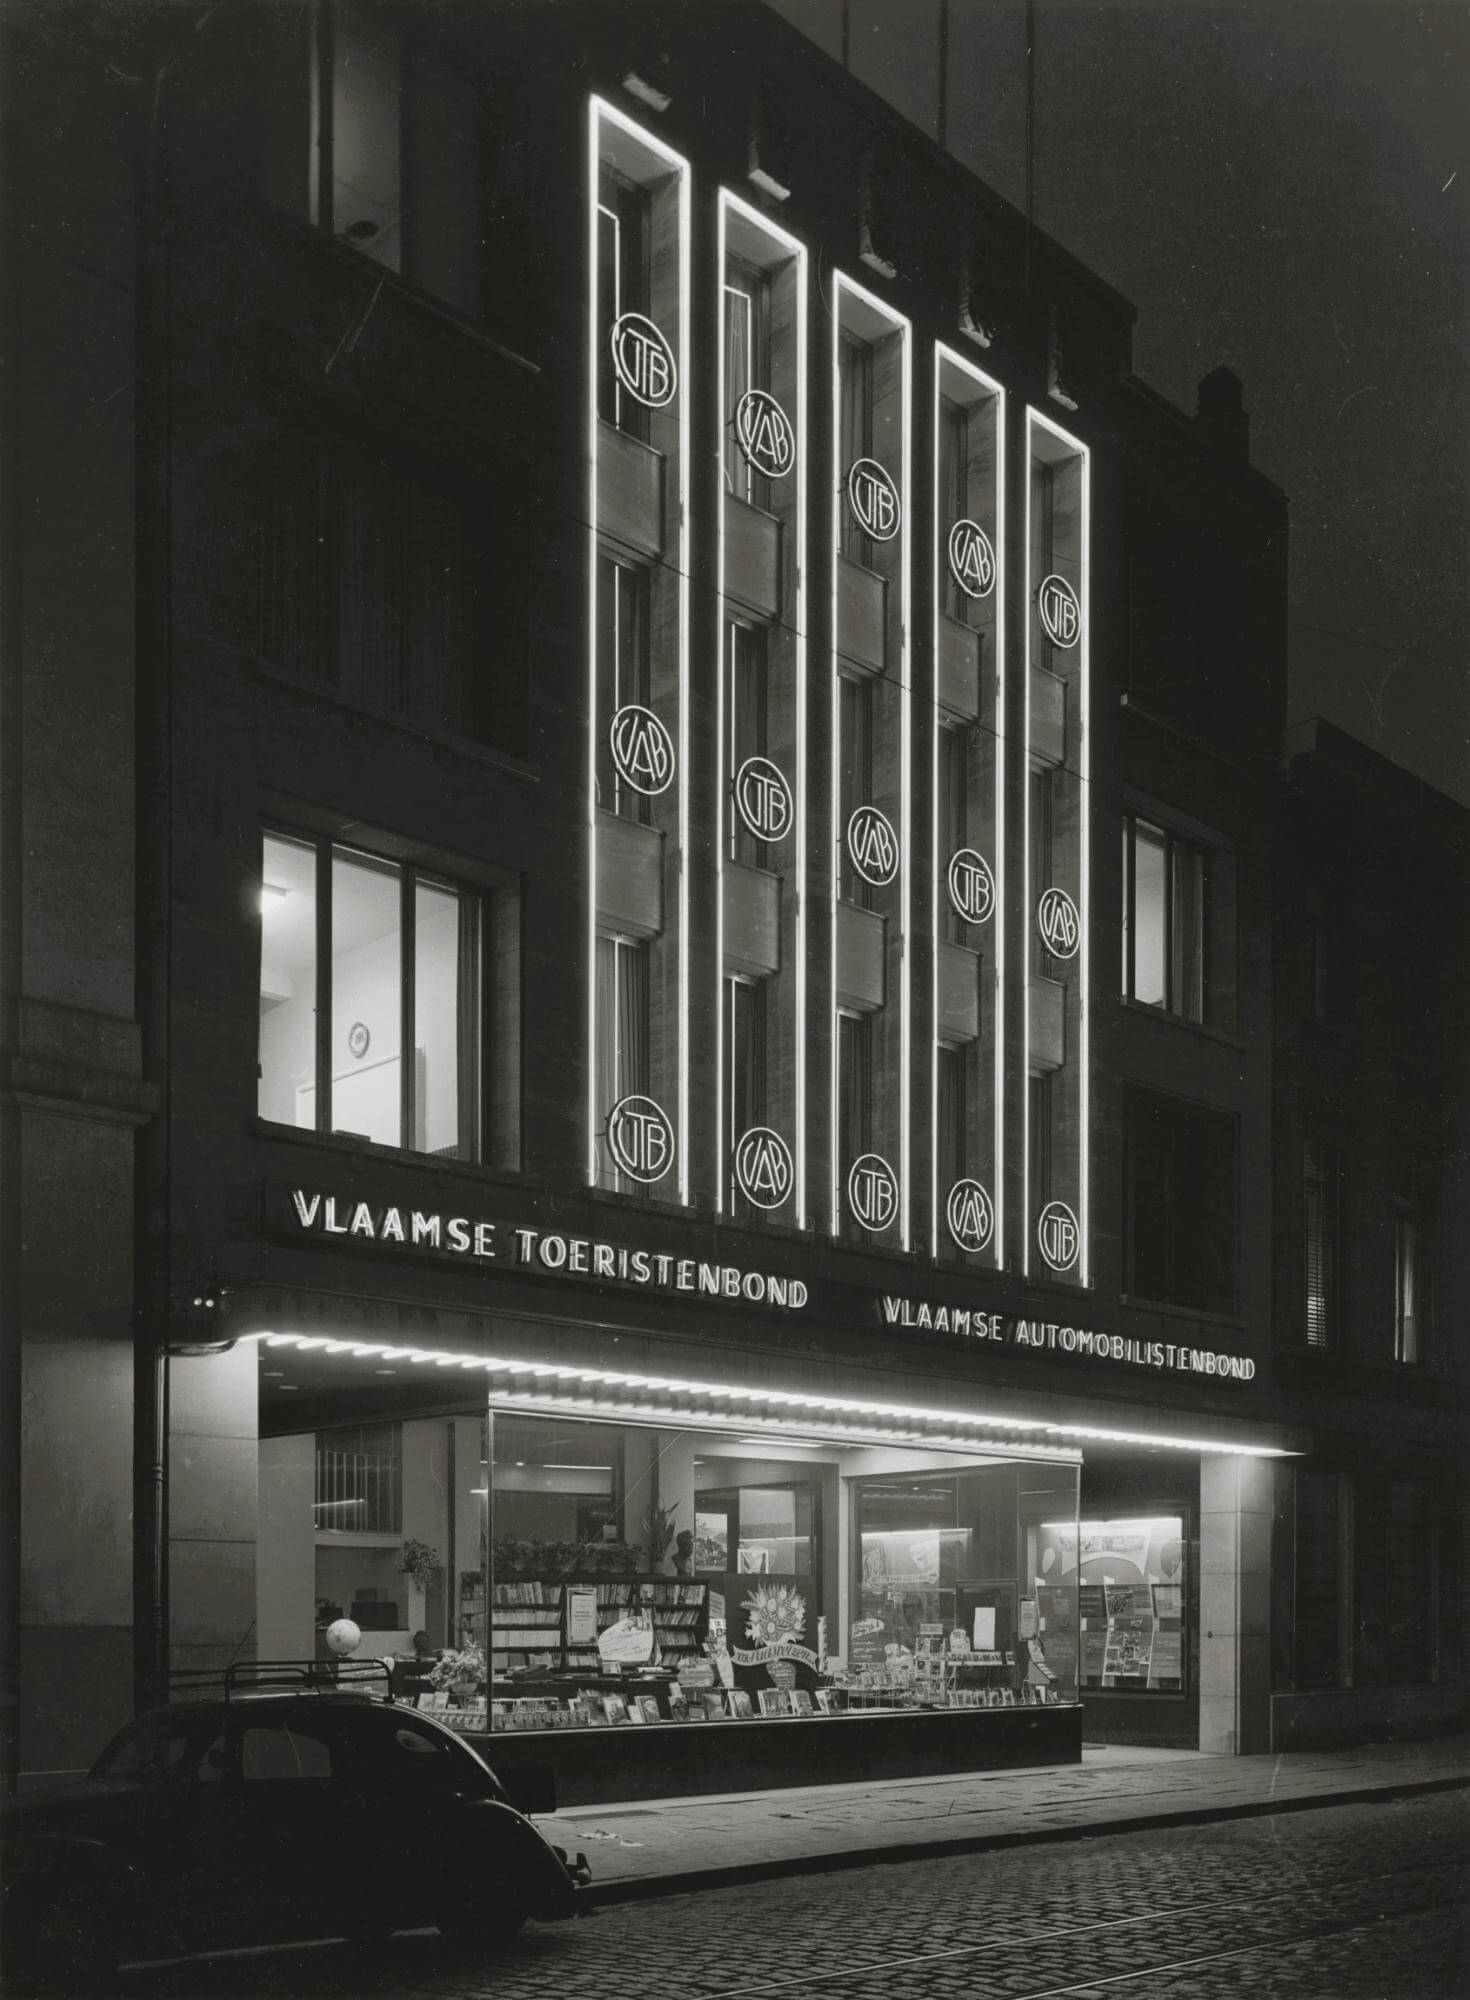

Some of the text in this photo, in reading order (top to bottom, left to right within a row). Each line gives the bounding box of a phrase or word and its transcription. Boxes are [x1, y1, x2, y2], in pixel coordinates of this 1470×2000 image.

[619, 327, 669, 398] VTB
[744, 401, 788, 464] VAB
[855, 471, 895, 530] VTB
[954, 528, 991, 587] VAB
[1043, 586, 1077, 640] VTB
[618, 715, 668, 782] VAB
[743, 771, 786, 832] VTB
[853, 815, 893, 874] VAB
[953, 861, 990, 915] VTB
[1042, 895, 1077, 948] VAB
[616, 1110, 667, 1171] VTB
[742, 1136, 787, 1197] VAB
[853, 1168, 893, 1222] VTB
[952, 1187, 989, 1241] VAB
[293, 1189, 808, 1308] VLAAMSE TOERISTENBOND
[1043, 1214, 1076, 1263] VTB
[883, 1296, 1256, 1380] VLAAMSE AUTOMOBILISTENBOND
